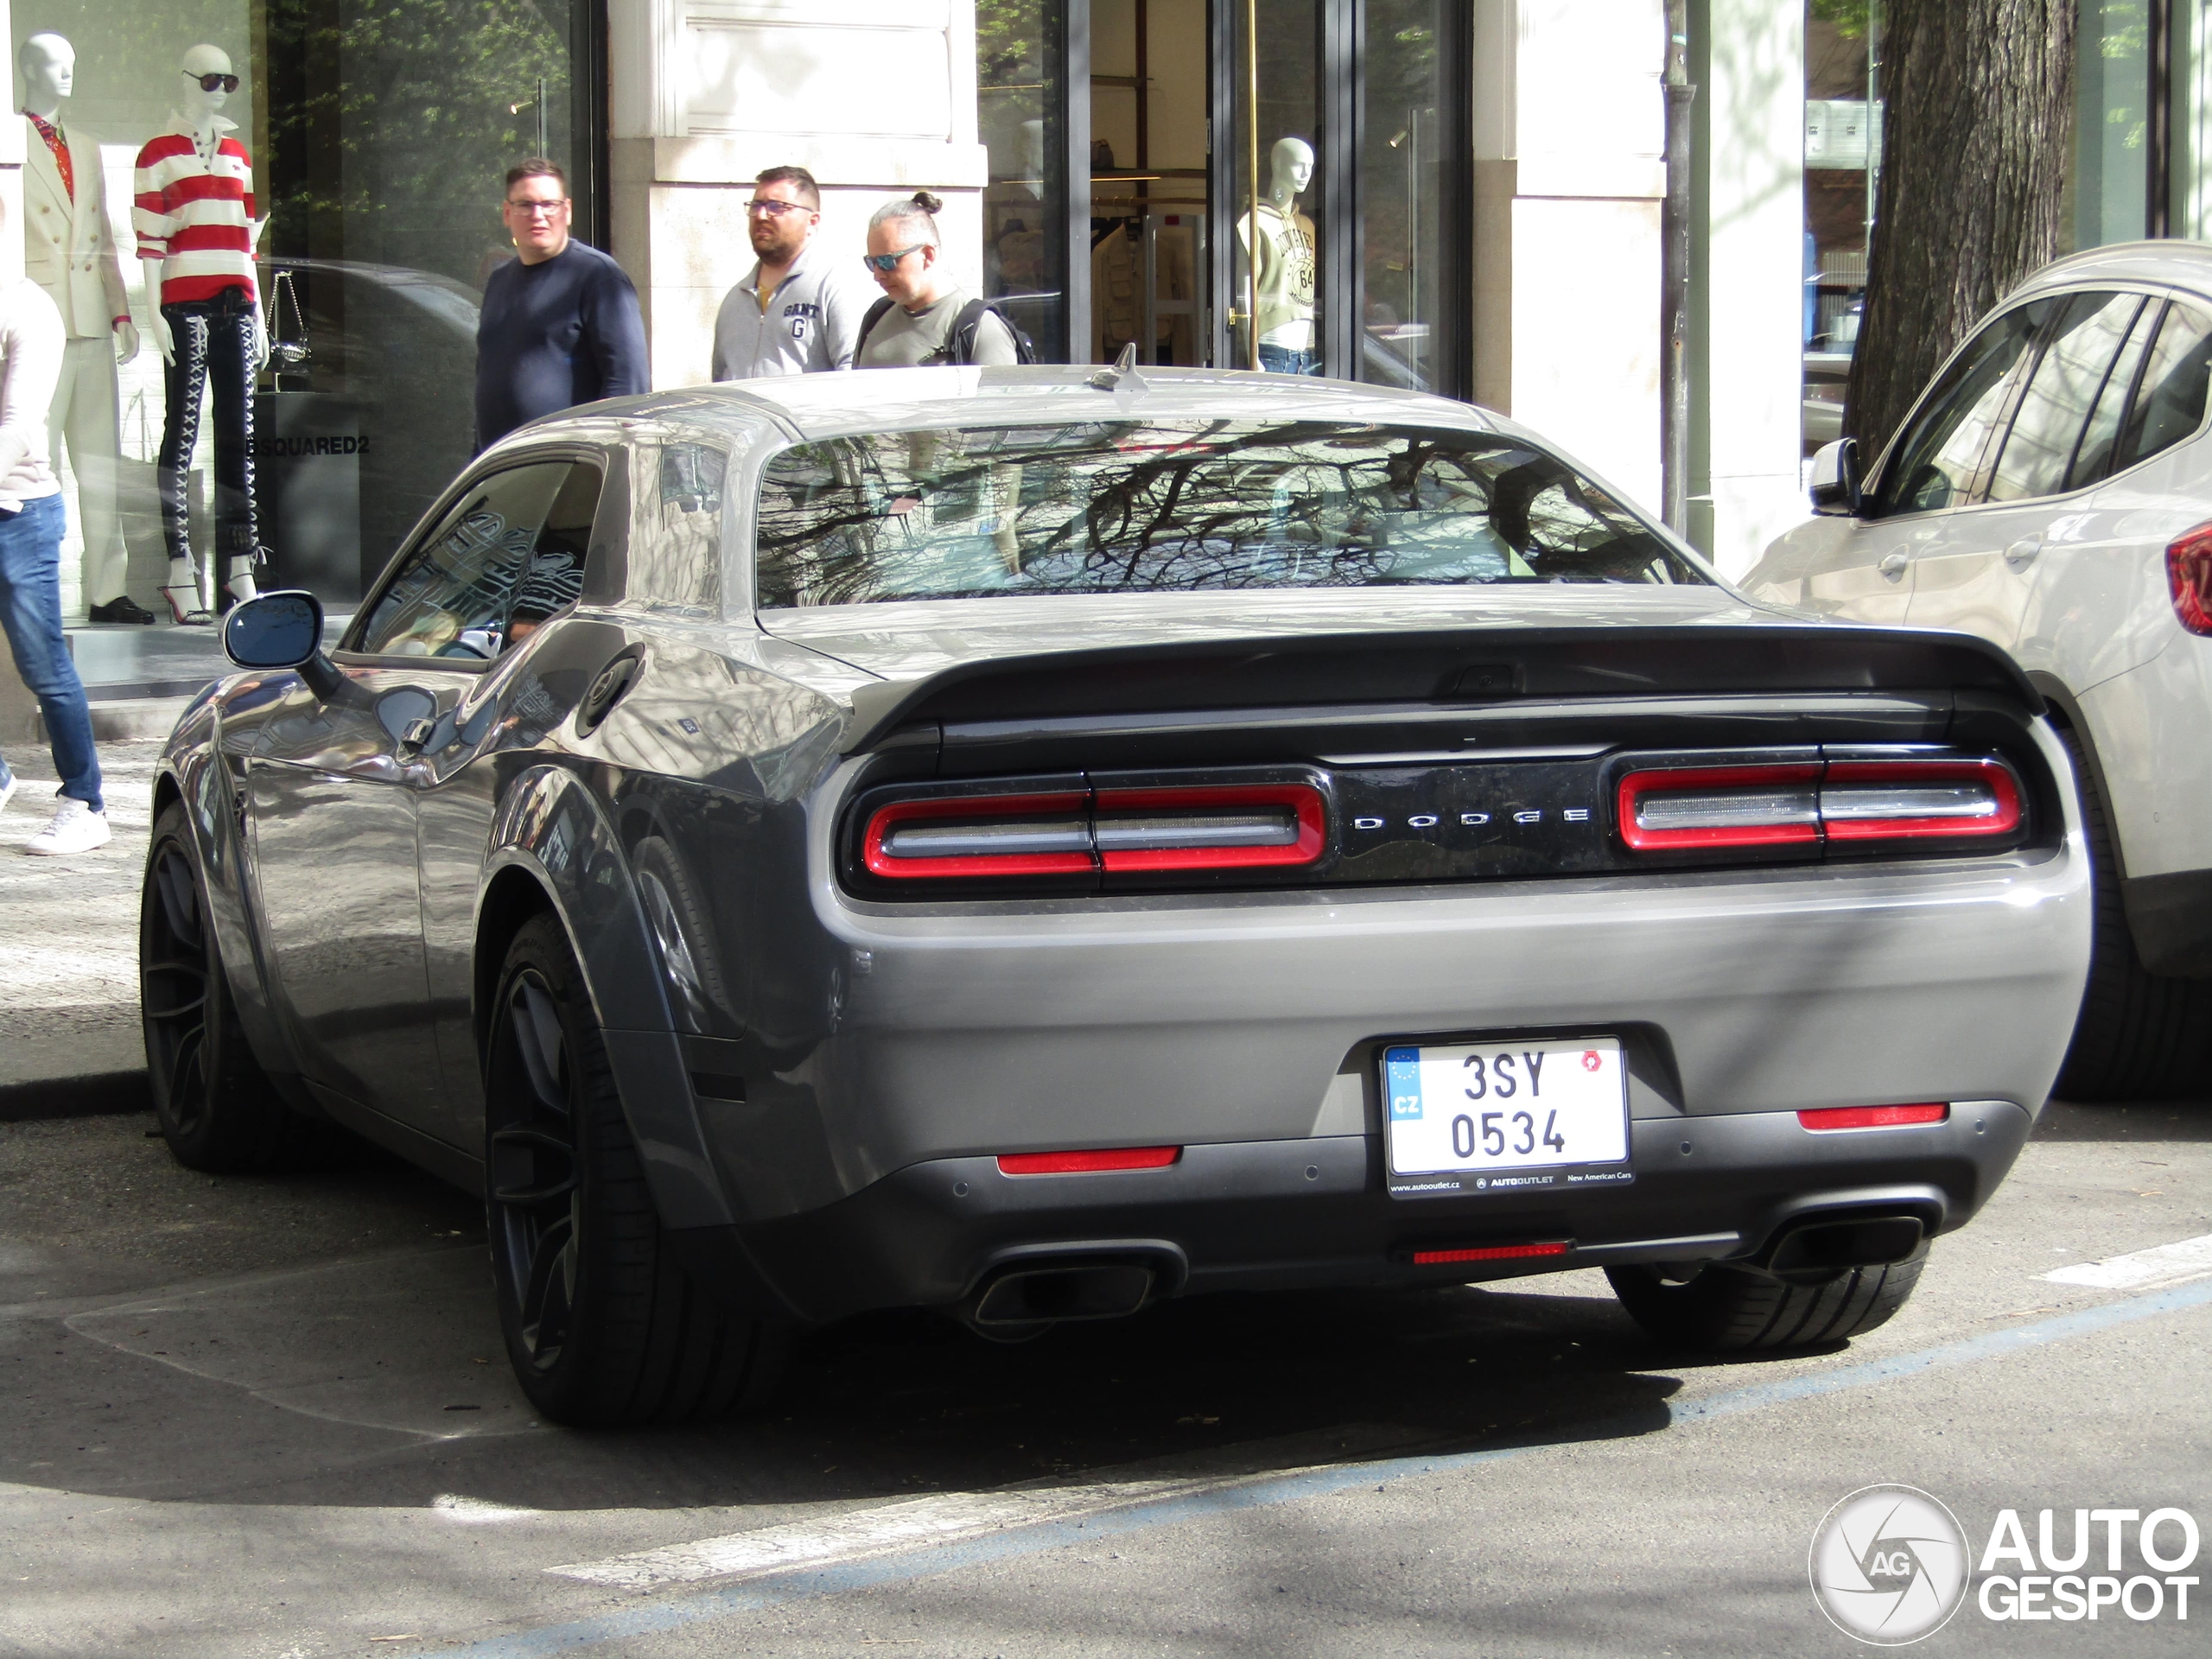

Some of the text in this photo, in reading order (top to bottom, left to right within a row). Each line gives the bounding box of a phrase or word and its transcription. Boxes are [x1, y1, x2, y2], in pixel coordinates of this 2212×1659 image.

[1300, 270, 1313, 289] 64
[784, 302, 820, 319] GANT
[791, 318, 805, 338] G
[1354, 808, 1589, 830] DODGE
[1463, 1051, 1545, 1100] 3SY
[1394, 1096, 1420, 1114] CZ
[1452, 1109, 1565, 1159] 0534
[1491, 1176, 1554, 1187] AUTOOUTLET
[1585, 1173, 1616, 1181] American
[1617, 1172, 1632, 1180] Cars
[1390, 1181, 1460, 1192] www.autooutlet.cz
